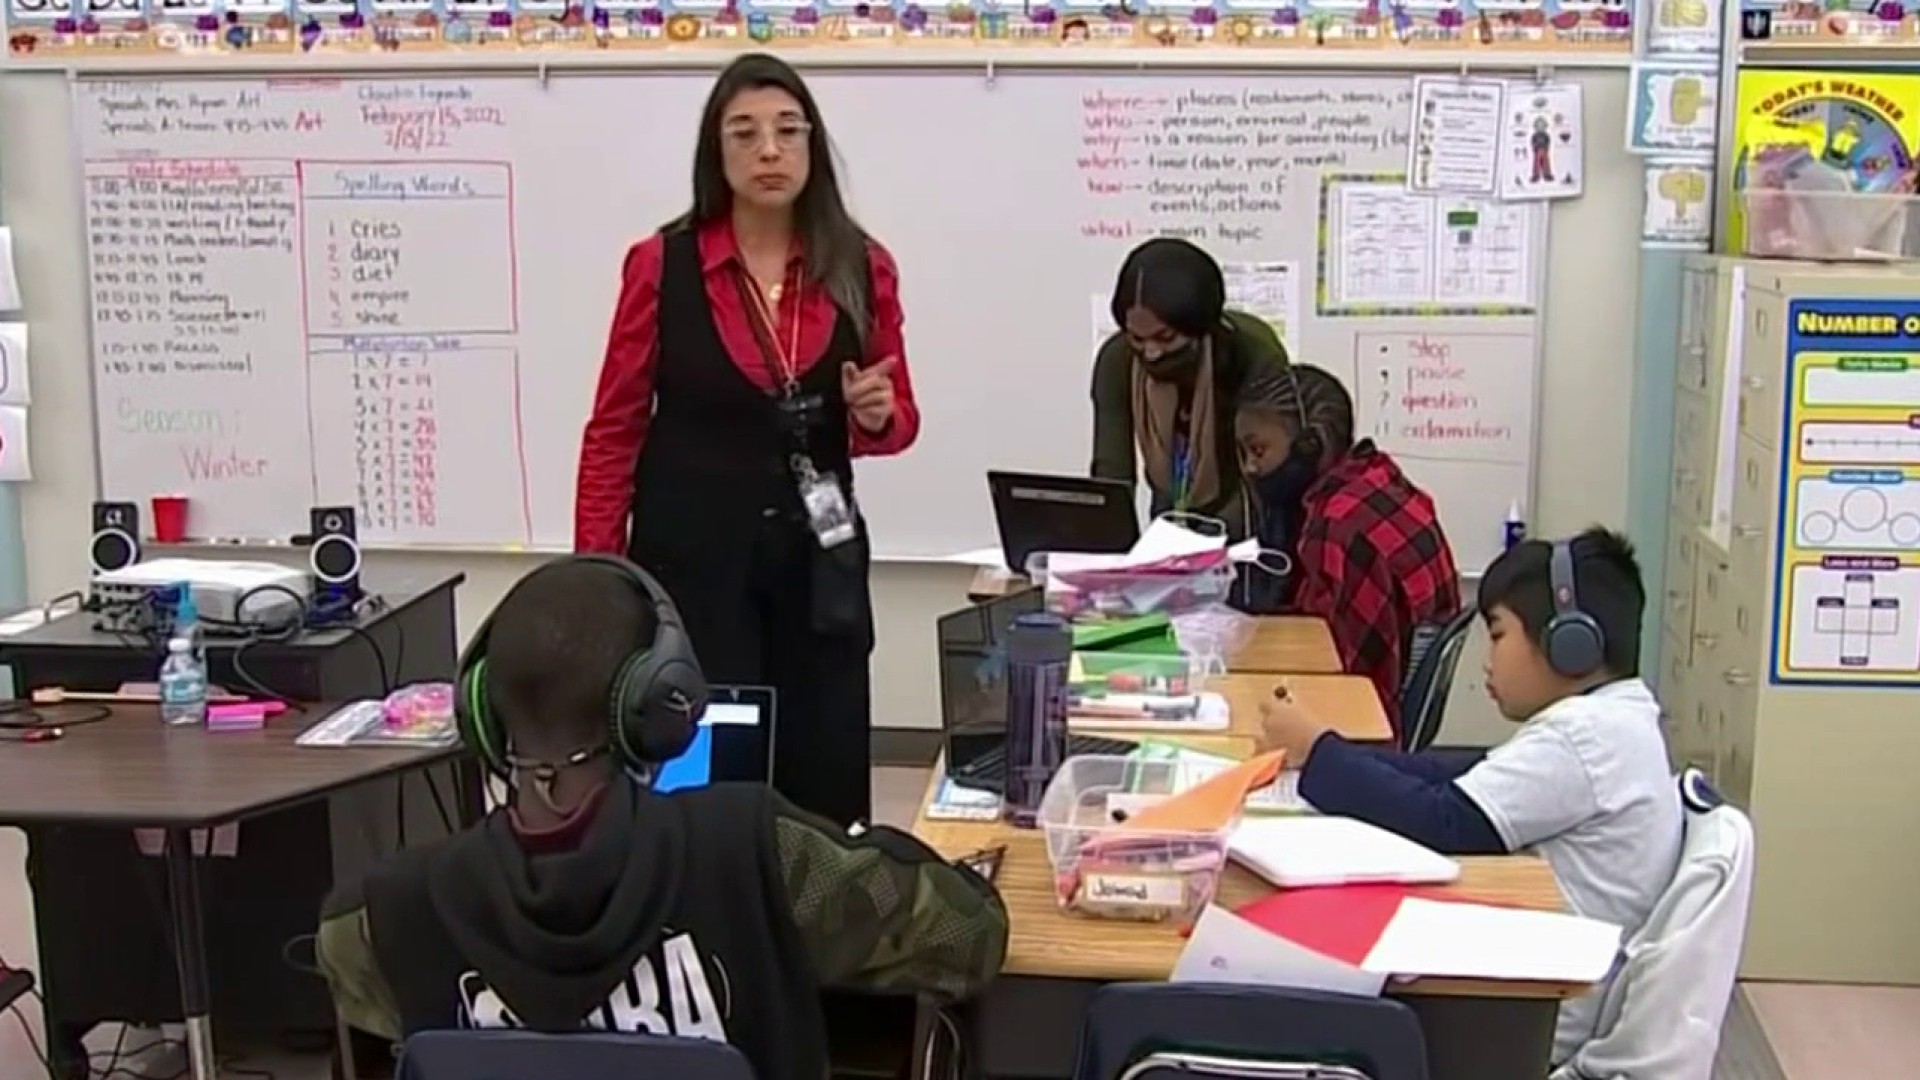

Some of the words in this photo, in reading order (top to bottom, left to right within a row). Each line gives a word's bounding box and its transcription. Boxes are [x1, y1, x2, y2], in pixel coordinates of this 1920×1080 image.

[1083, 90, 1141, 109] where
[1176, 88, 1238, 113] places
[294, 110, 325, 132] Art
[1085, 113, 1133, 130] who
[1083, 135, 1121, 154] why
[1076, 152, 1127, 170] when
[334, 170, 407, 200] Spelling
[411, 172, 477, 196] Words
[1087, 177, 1122, 193] how
[1146, 177, 1249, 198] description
[1260, 175, 1287, 195] of
[1081, 219, 1132, 238] what
[1218, 222, 1263, 244] topic
[326, 243, 338, 262] 2
[350, 240, 400, 267] diary
[328, 265, 340, 281] 3
[351, 261, 393, 283] diet
[328, 288, 341, 307] 4
[350, 289, 410, 309] empire
[329, 310, 342, 327] 5
[354, 308, 403, 326] shine
[1797, 310, 1898, 335] NUMBER
[1407, 333, 1450, 366] stop
[1406, 366, 1467, 393] pause
[1401, 391, 1479, 414] question
[176, 442, 268, 481] Winter
